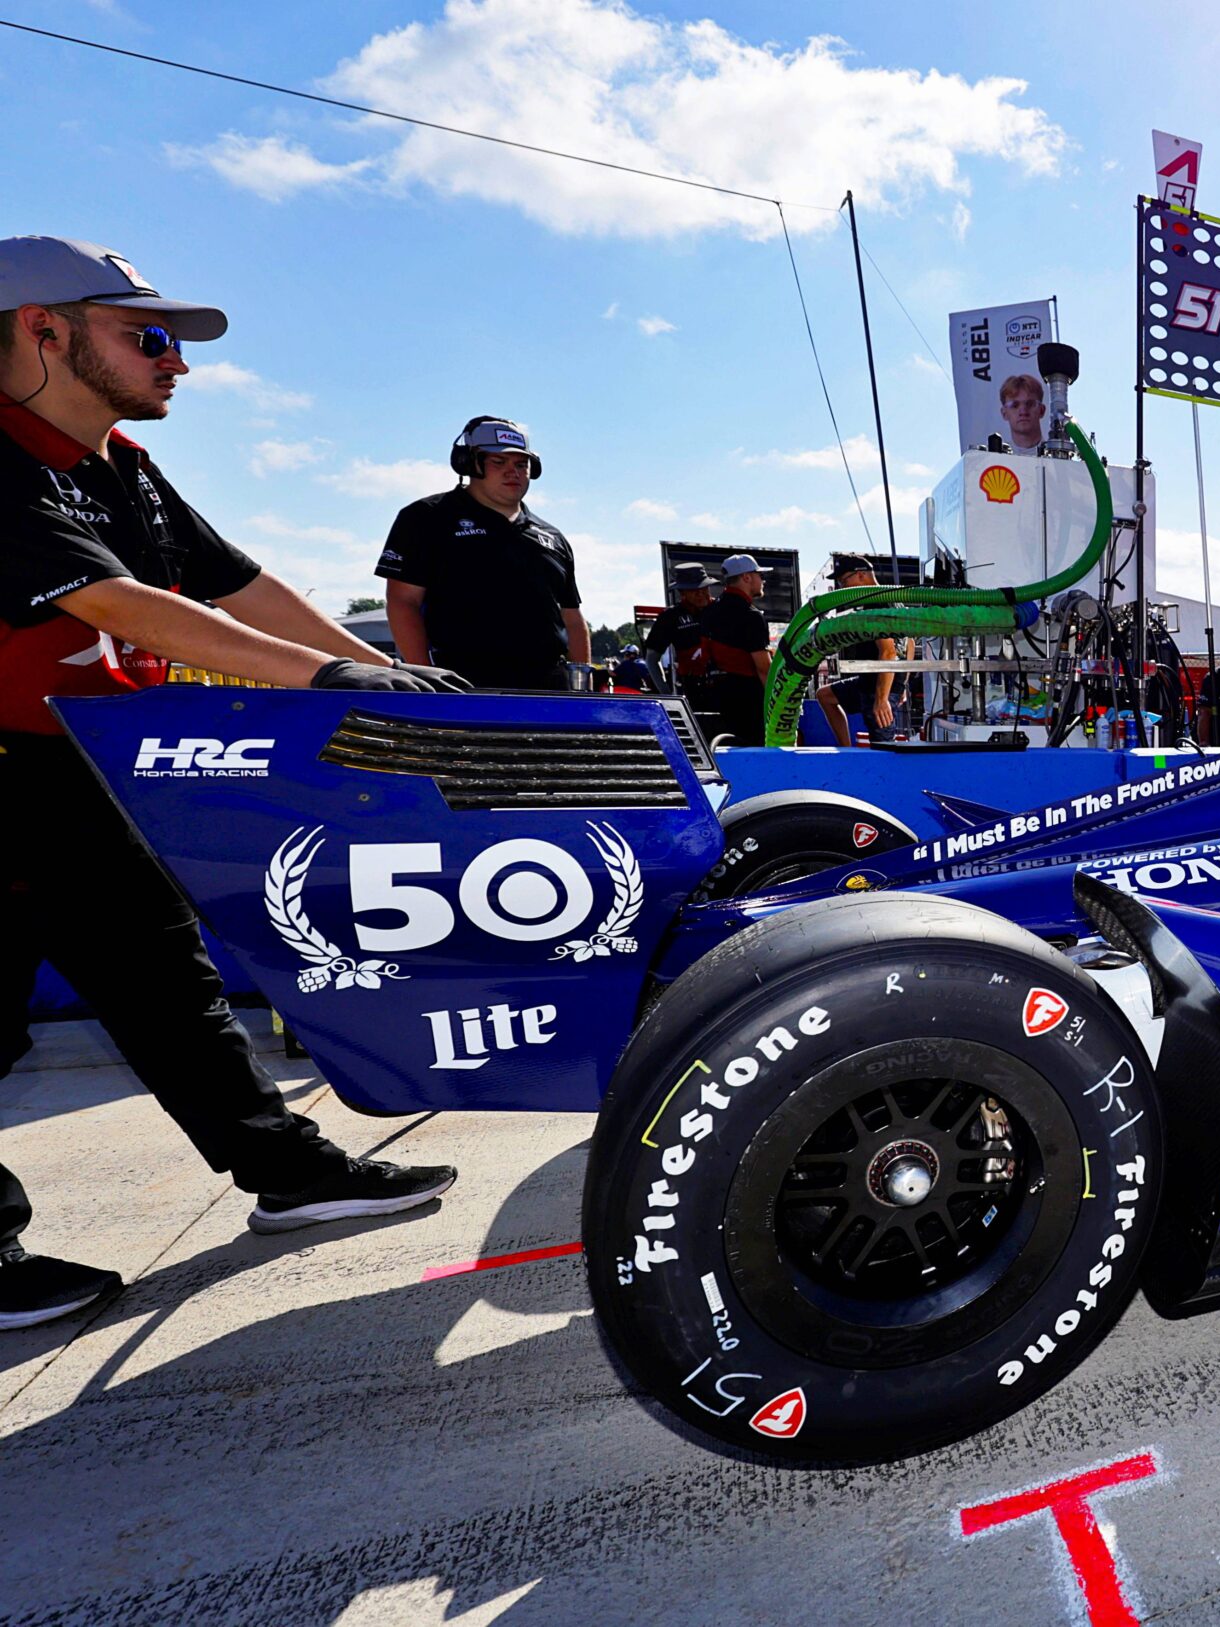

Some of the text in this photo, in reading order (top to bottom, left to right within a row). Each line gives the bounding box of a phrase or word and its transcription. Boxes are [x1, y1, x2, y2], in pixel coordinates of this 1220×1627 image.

[1006, 333, 1042, 343] INDYCAR
[1022, 322, 1038, 330] NTT
[970, 318, 992, 382] ABEL
[46, 576, 89, 600] IMPACT
[134, 738, 275, 769] HRC
[133, 769, 269, 778] Honda RACING
[946, 824, 1005, 858] Must
[1010, 814, 1041, 839] Be
[1045, 807, 1067, 828] In
[1071, 793, 1113, 818] The
[1117, 771, 1175, 805] Front
[1076, 846, 1198, 872] POWERED
[349, 838, 594, 952] 50
[886, 972, 904, 995] R
[421, 1003, 557, 1070] Lite
[634, 1006, 831, 1273] Firestone
[997, 1154, 1146, 1387] Firestone
